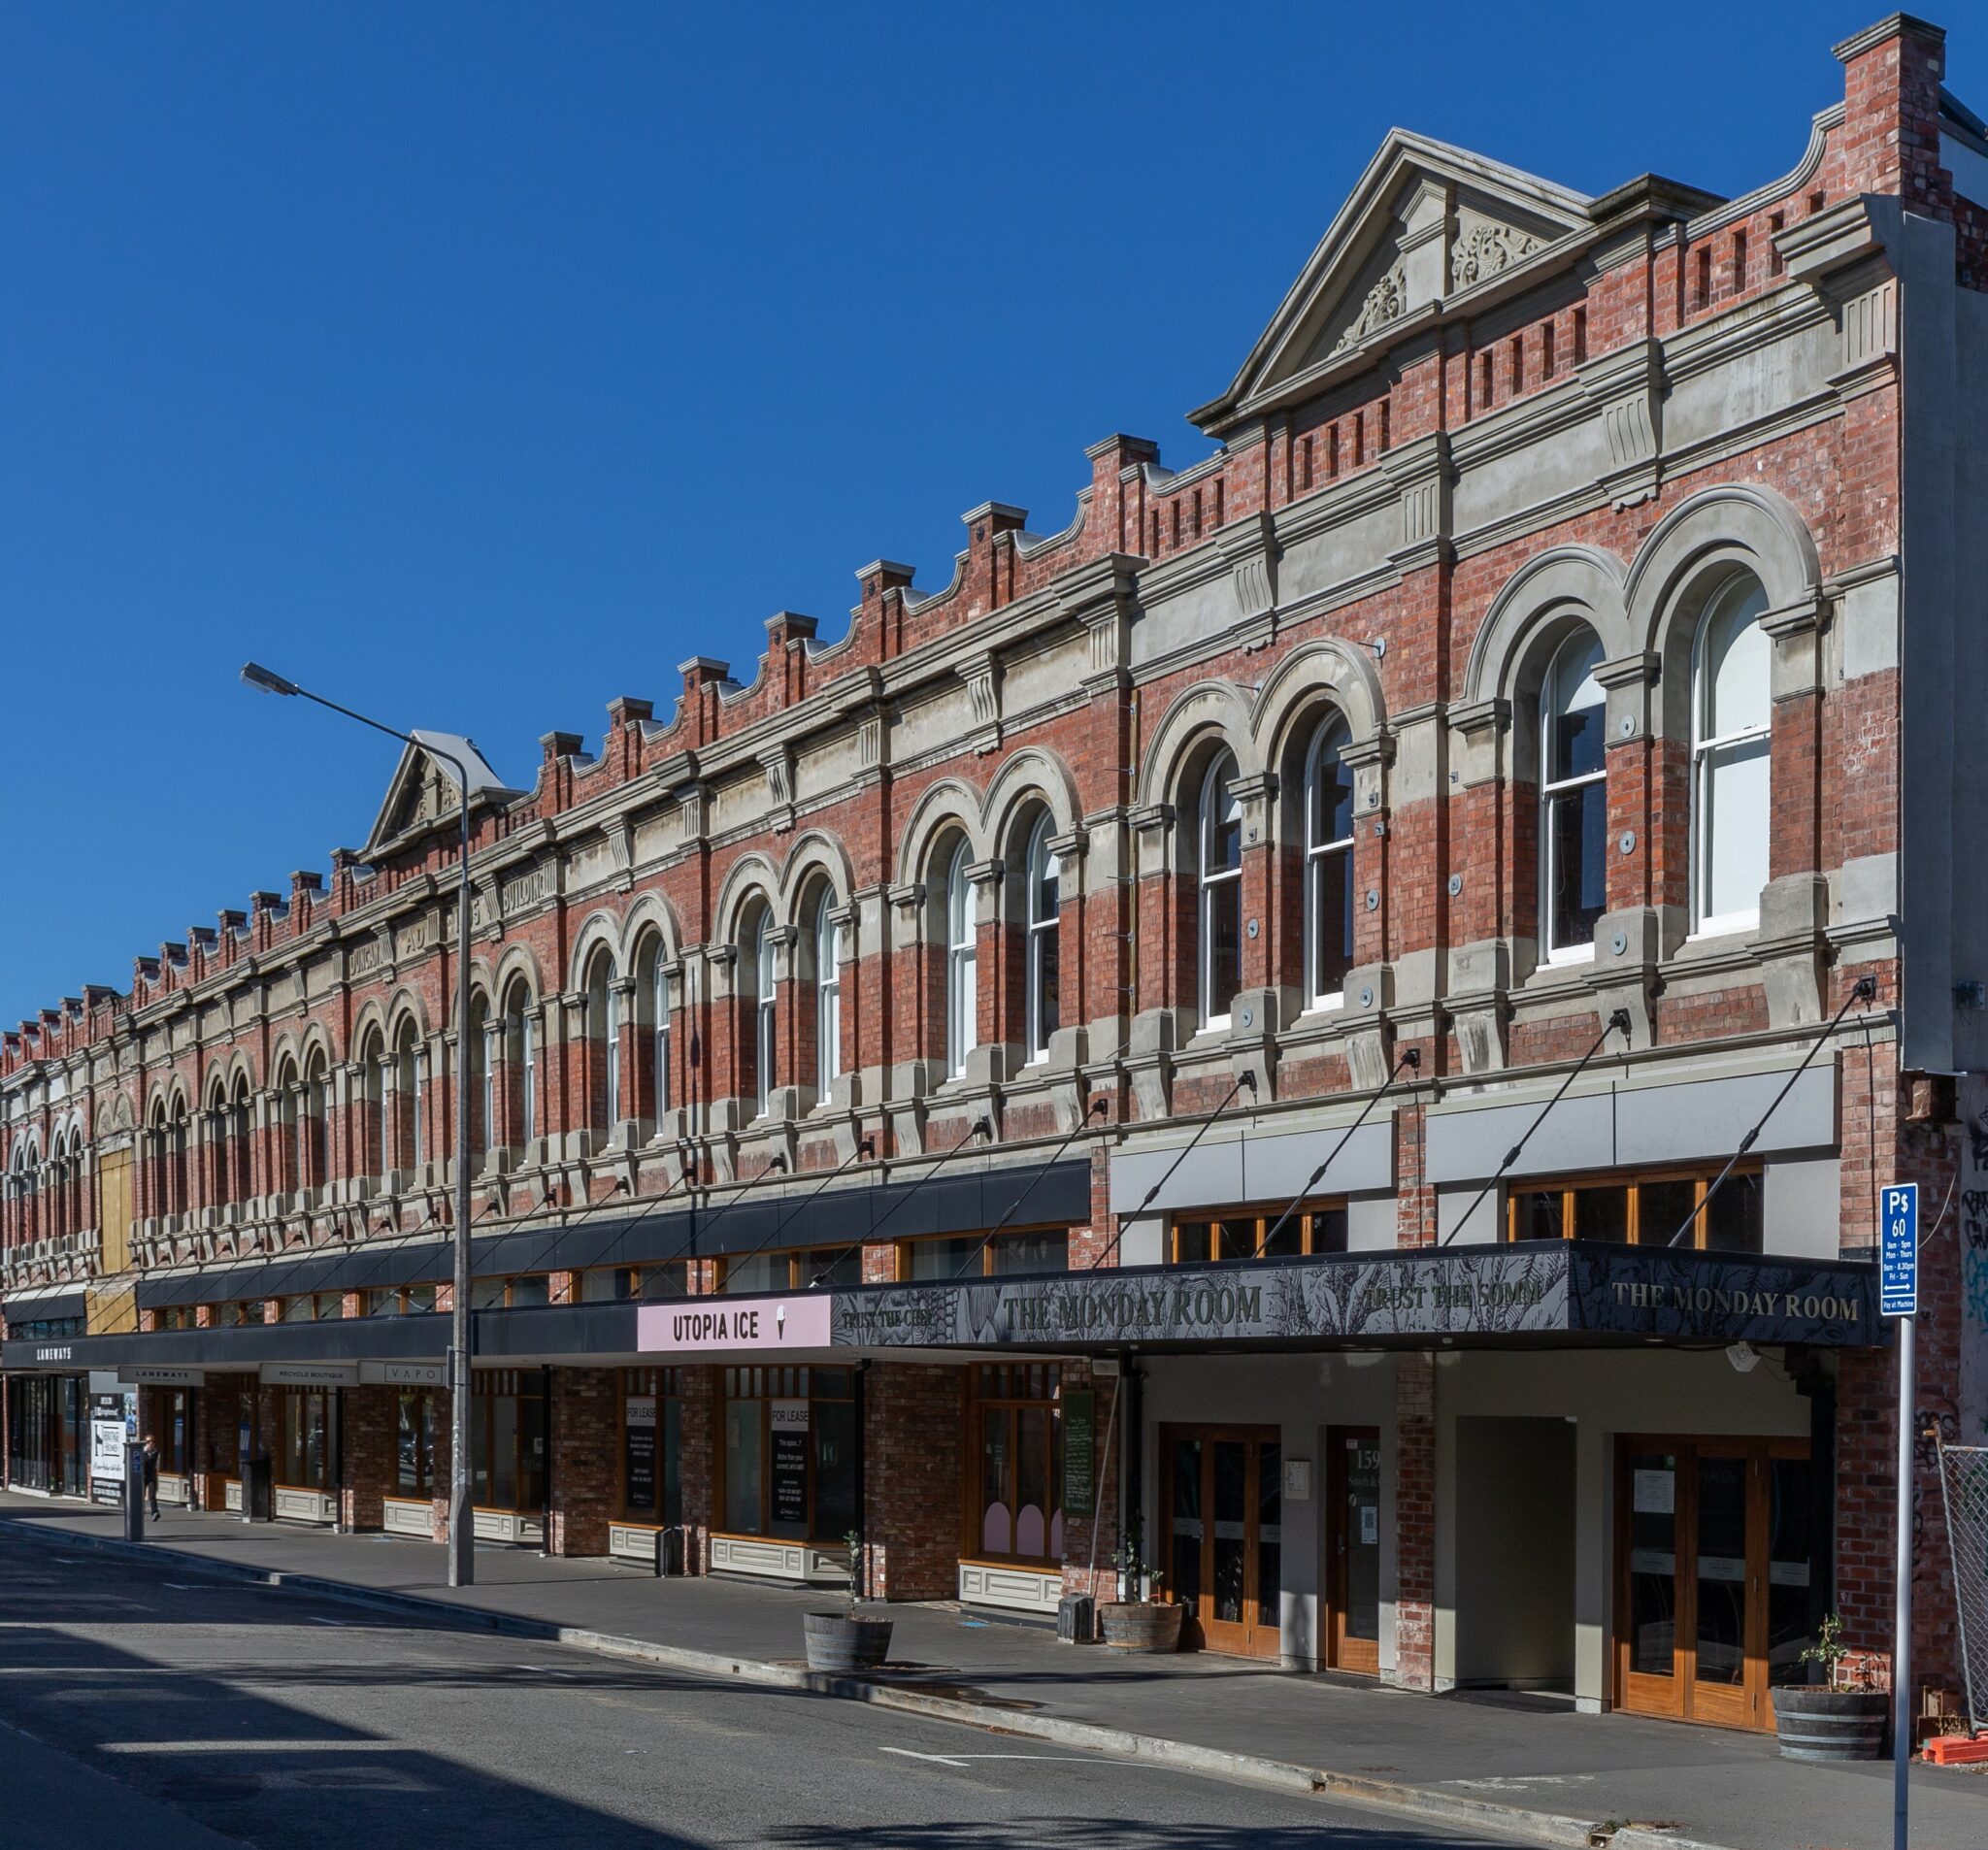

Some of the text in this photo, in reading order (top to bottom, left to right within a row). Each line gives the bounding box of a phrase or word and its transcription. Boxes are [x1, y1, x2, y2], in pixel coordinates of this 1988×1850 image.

[1892, 1218, 1905, 1238] 60
[1901, 1240, 1911, 1249] 5pm
[1897, 1262, 1914, 1272] 8.30pm
[1364, 1279, 1542, 1310] TRUST THE SOMM
[1612, 1281, 1859, 1321] THE MONDAY ROOM
[1004, 1285, 1262, 1331] THE MONDAY ROOM
[1897, 1300, 1913, 1308] Machine
[674, 1311, 759, 1341] UTOPIA ICE
[842, 1308, 934, 1330] TRUST THE CHEF
[37, 1346, 71, 1361] LANEWAYS
[136, 1371, 189, 1379] LANEWAYS
[391, 1370, 436, 1379] VAPO
[627, 1406, 656, 1418] FOR LEASE
[773, 1409, 809, 1422] FOR LEASE
[1357, 1449, 1380, 1470] 159
